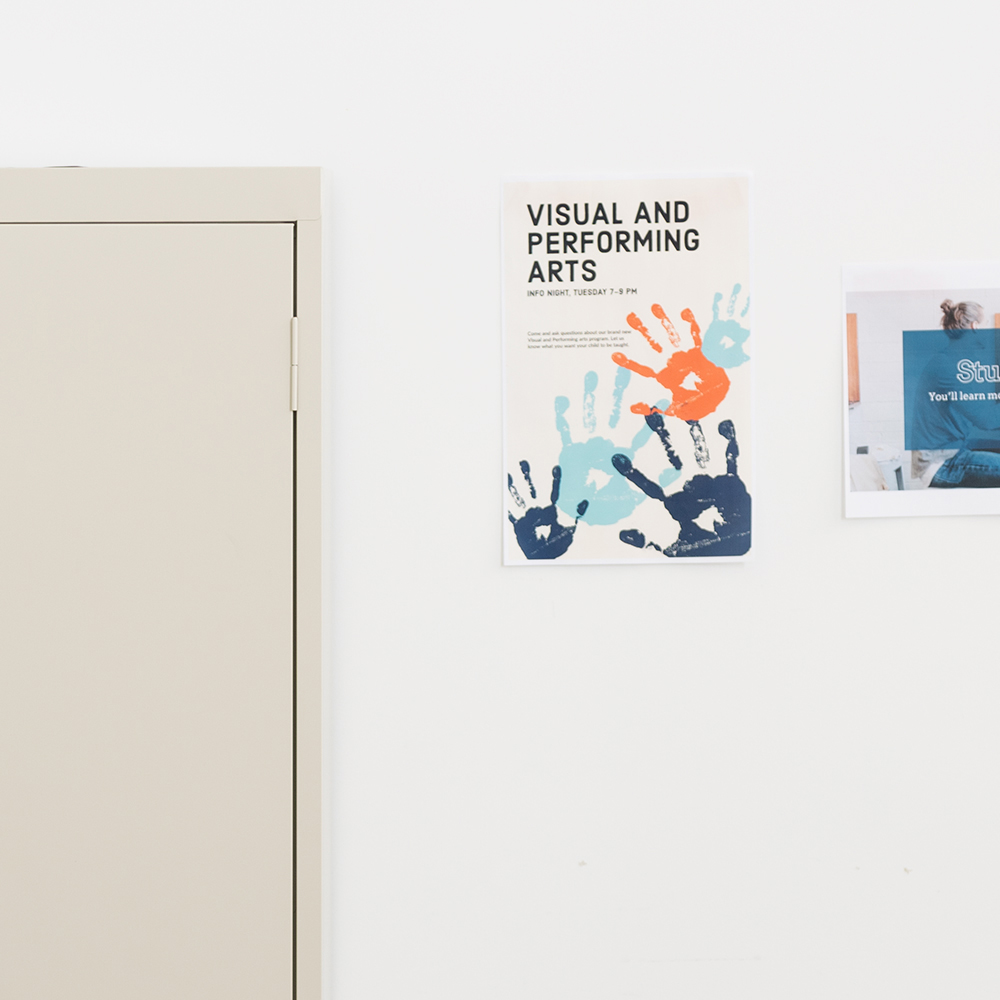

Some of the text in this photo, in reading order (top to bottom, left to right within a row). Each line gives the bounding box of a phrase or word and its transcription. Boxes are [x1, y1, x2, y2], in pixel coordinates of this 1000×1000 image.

[527, 200, 690, 226] VISUAL AND
[528, 228, 700, 254] PERFORMING
[528, 259, 597, 282] ARTS
[547, 289, 571, 297] NIGHT,
[574, 288, 607, 296] TUESDAY
[956, 359, 1000, 383] Stu
[928, 391, 958, 401] You'll
[959, 391, 986, 401] learn
